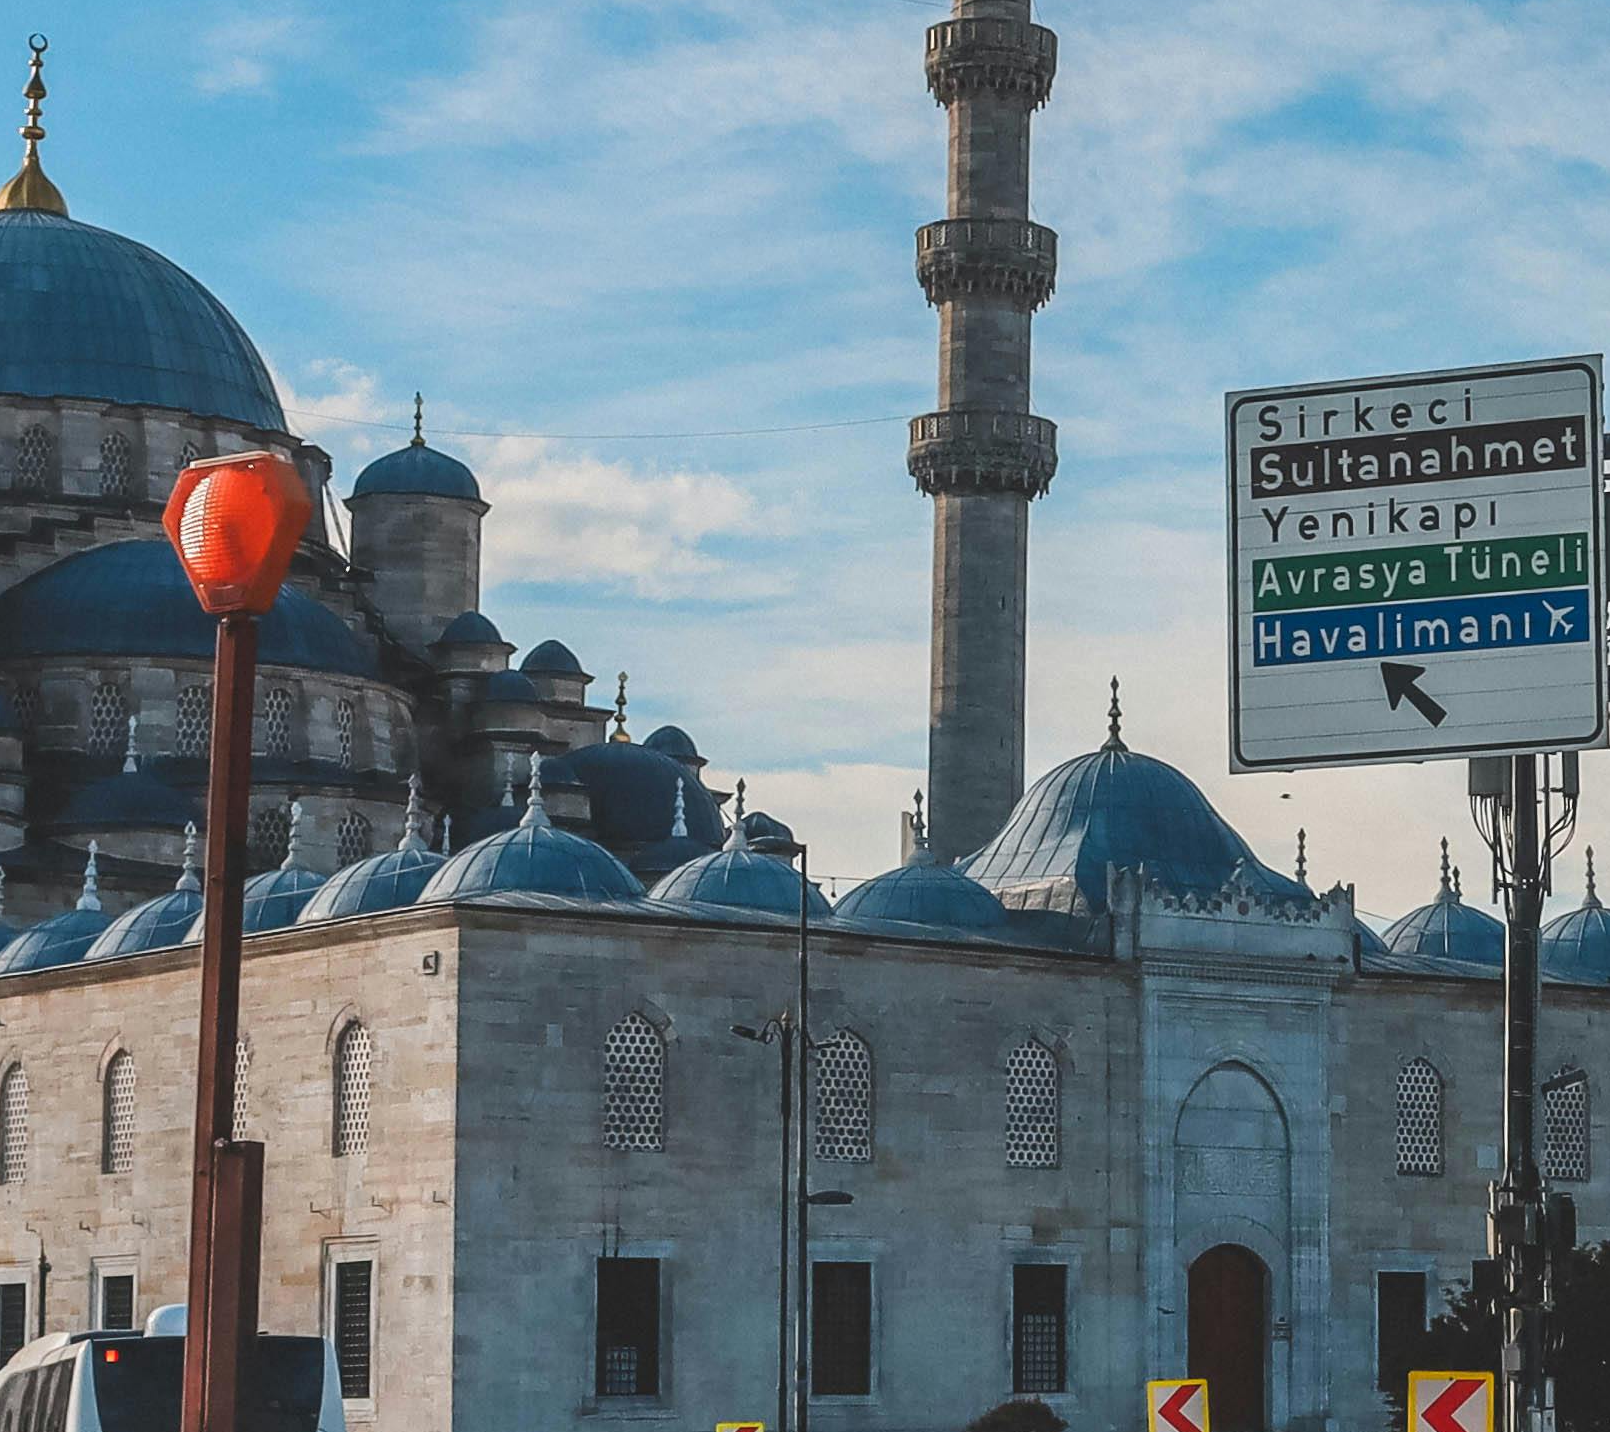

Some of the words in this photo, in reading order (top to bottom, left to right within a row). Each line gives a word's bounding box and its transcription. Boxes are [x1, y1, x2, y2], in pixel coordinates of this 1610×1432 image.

[1258, 388, 1473, 442] Sirkeci
[1259, 426, 1578, 491] Sultanahmet
[1261, 498, 1497, 543] Yenikapı
[1258, 557, 1427, 598] Avrasya
[1443, 537, 1583, 583] Tüneli
[1258, 611, 1531, 660] Havalimanı
